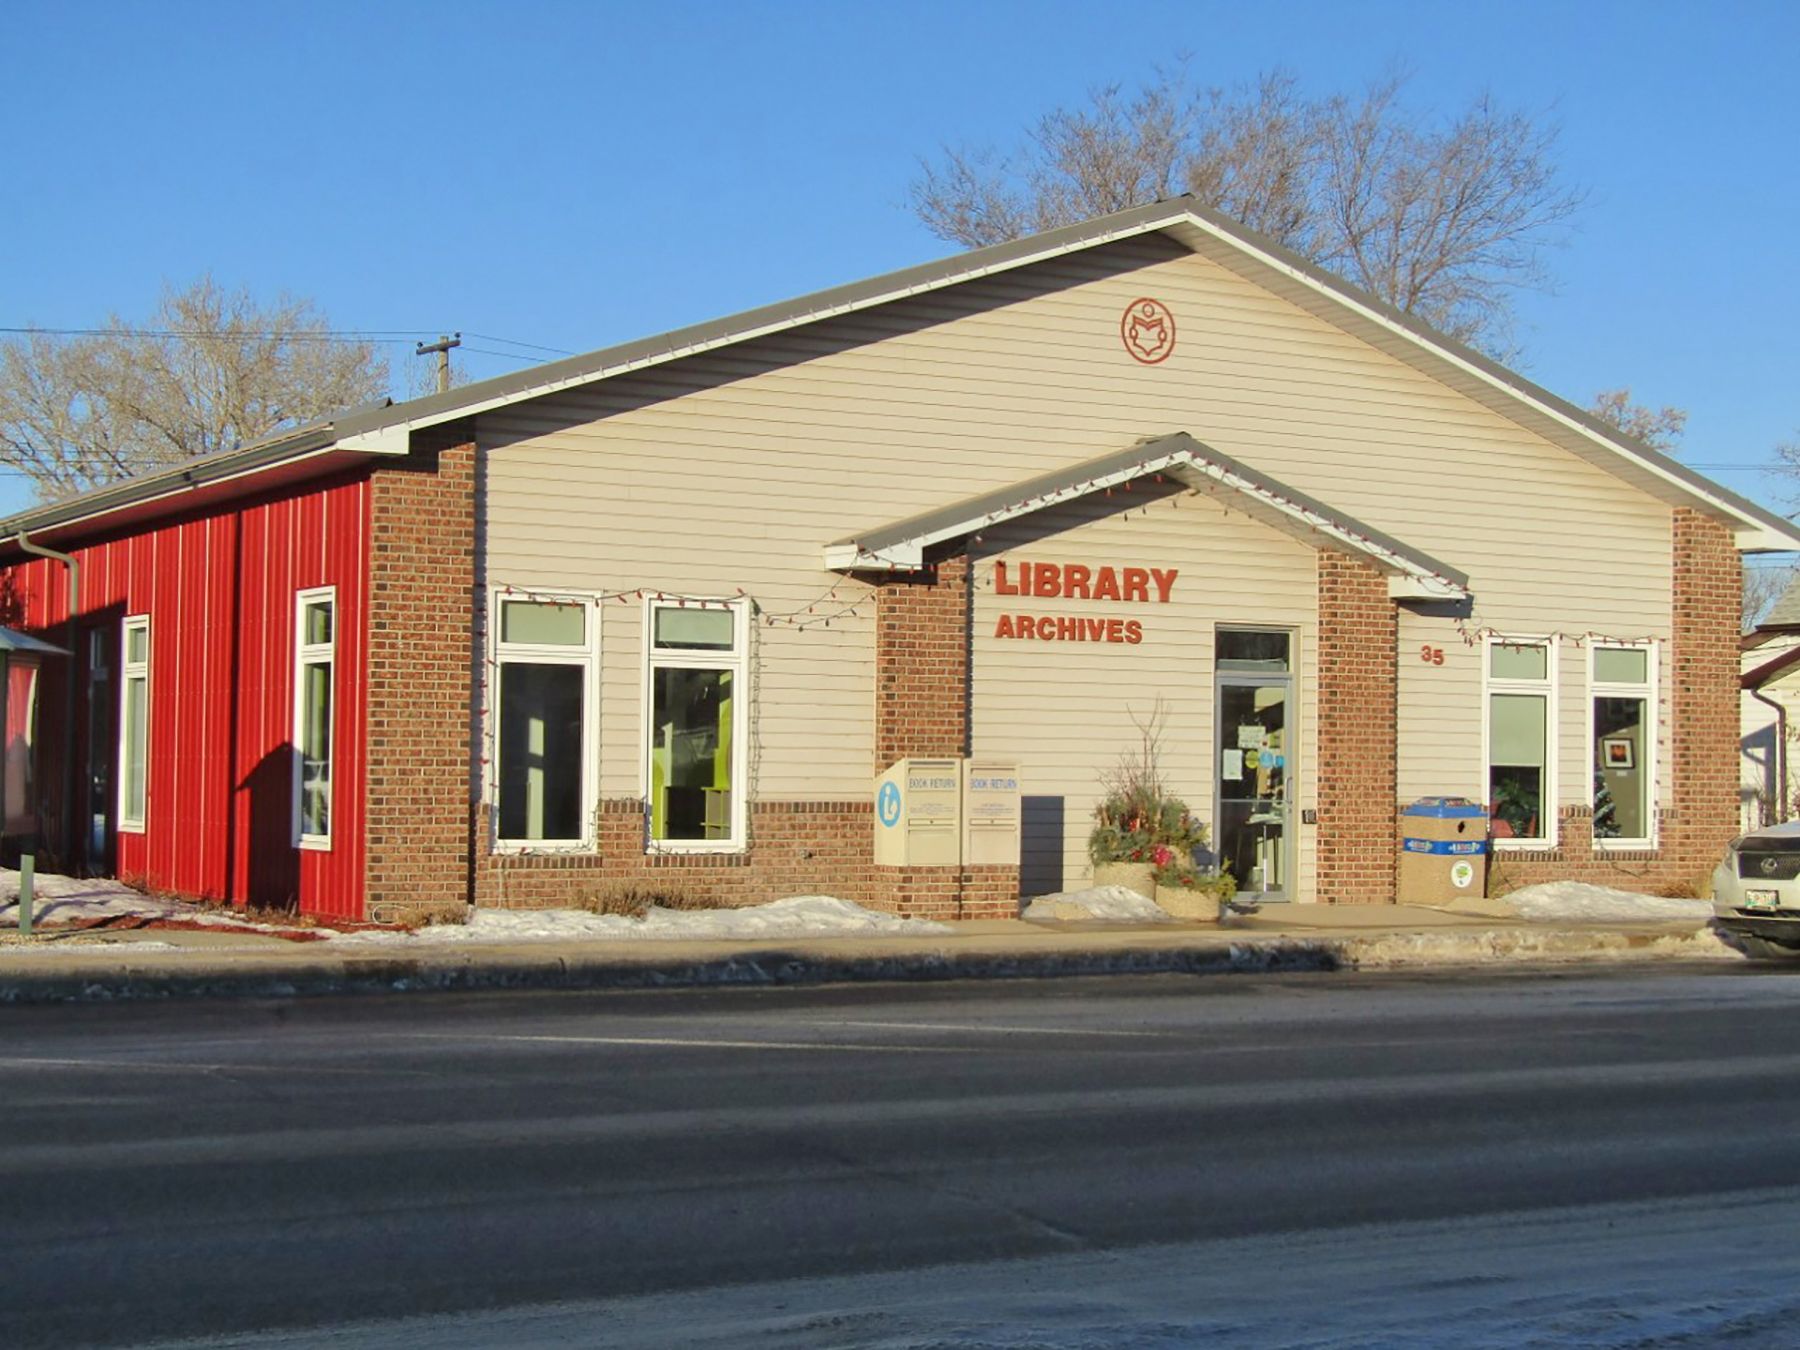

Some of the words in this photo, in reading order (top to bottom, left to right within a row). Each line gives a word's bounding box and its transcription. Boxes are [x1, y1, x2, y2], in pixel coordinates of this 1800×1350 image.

[995, 560, 1178, 603] LIBRARY
[995, 614, 1143, 645] ARCHIVES
[1421, 645, 1444, 665] 35
